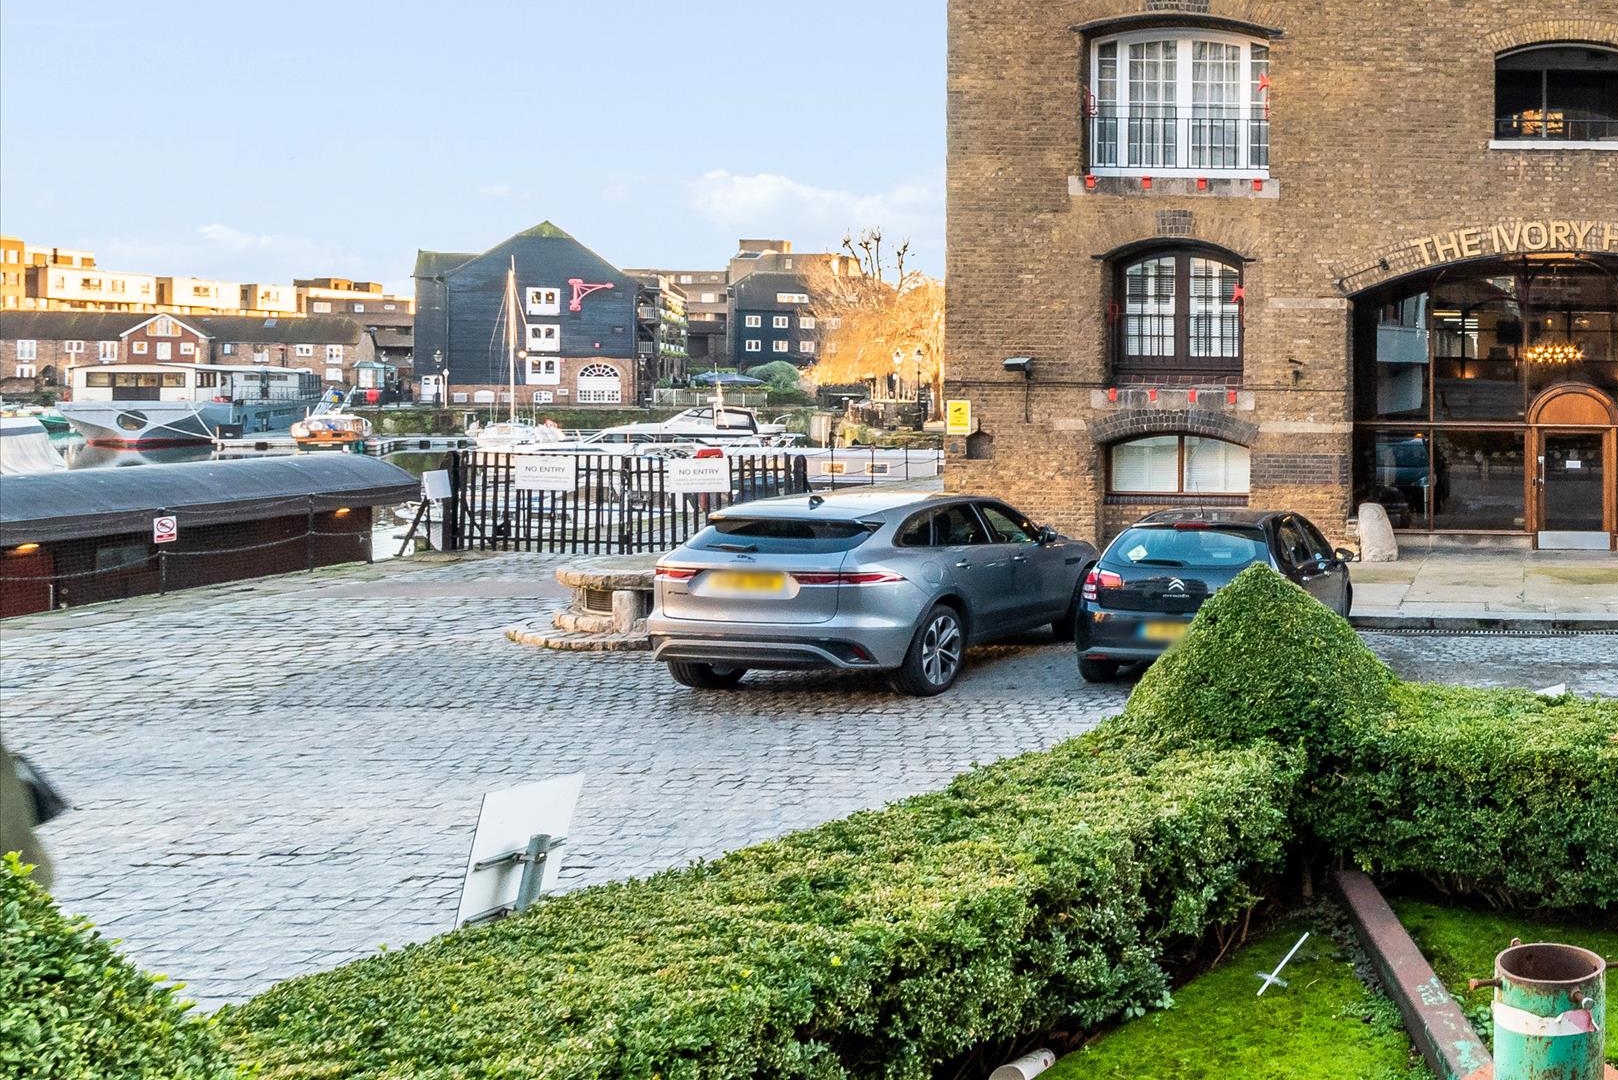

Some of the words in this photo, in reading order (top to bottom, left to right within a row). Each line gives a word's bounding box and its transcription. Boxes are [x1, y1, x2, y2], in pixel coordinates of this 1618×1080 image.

[1410, 227, 1482, 265] THE
[1492, 221, 1594, 253] IVORY
[525, 465, 538, 473] NO
[678, 468, 691, 476] NO
[693, 468, 719, 476] ENTRY
